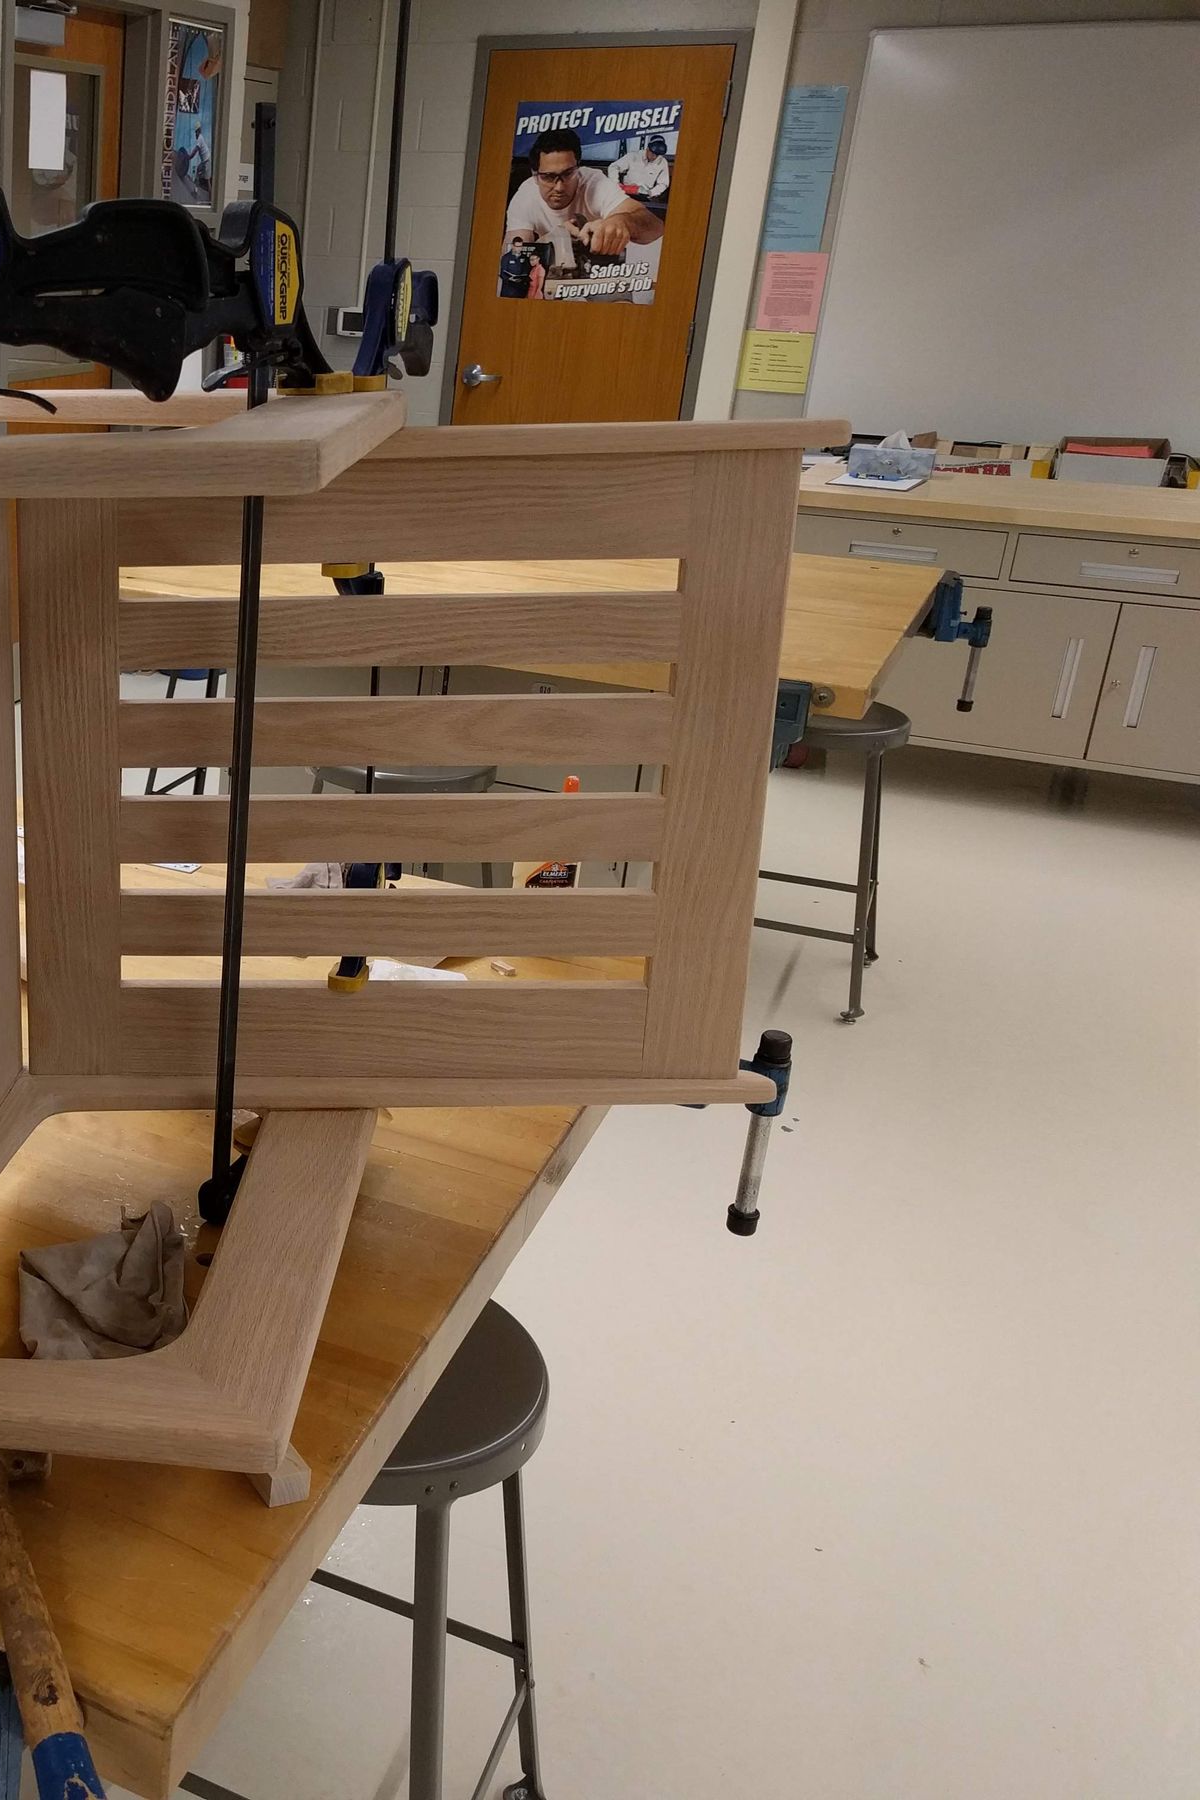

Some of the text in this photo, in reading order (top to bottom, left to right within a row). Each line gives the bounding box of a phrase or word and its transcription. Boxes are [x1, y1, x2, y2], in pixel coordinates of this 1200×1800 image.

[166, 27, 180, 88] PLANE
[162, 92, 177, 167] INCLINED
[516, 104, 682, 136] PROTECT YOURSELF
[279, 233, 289, 321] QUICK-GRIP
[554, 277, 652, 299] Everyone's Job
[589, 261, 650, 279] Safety is
